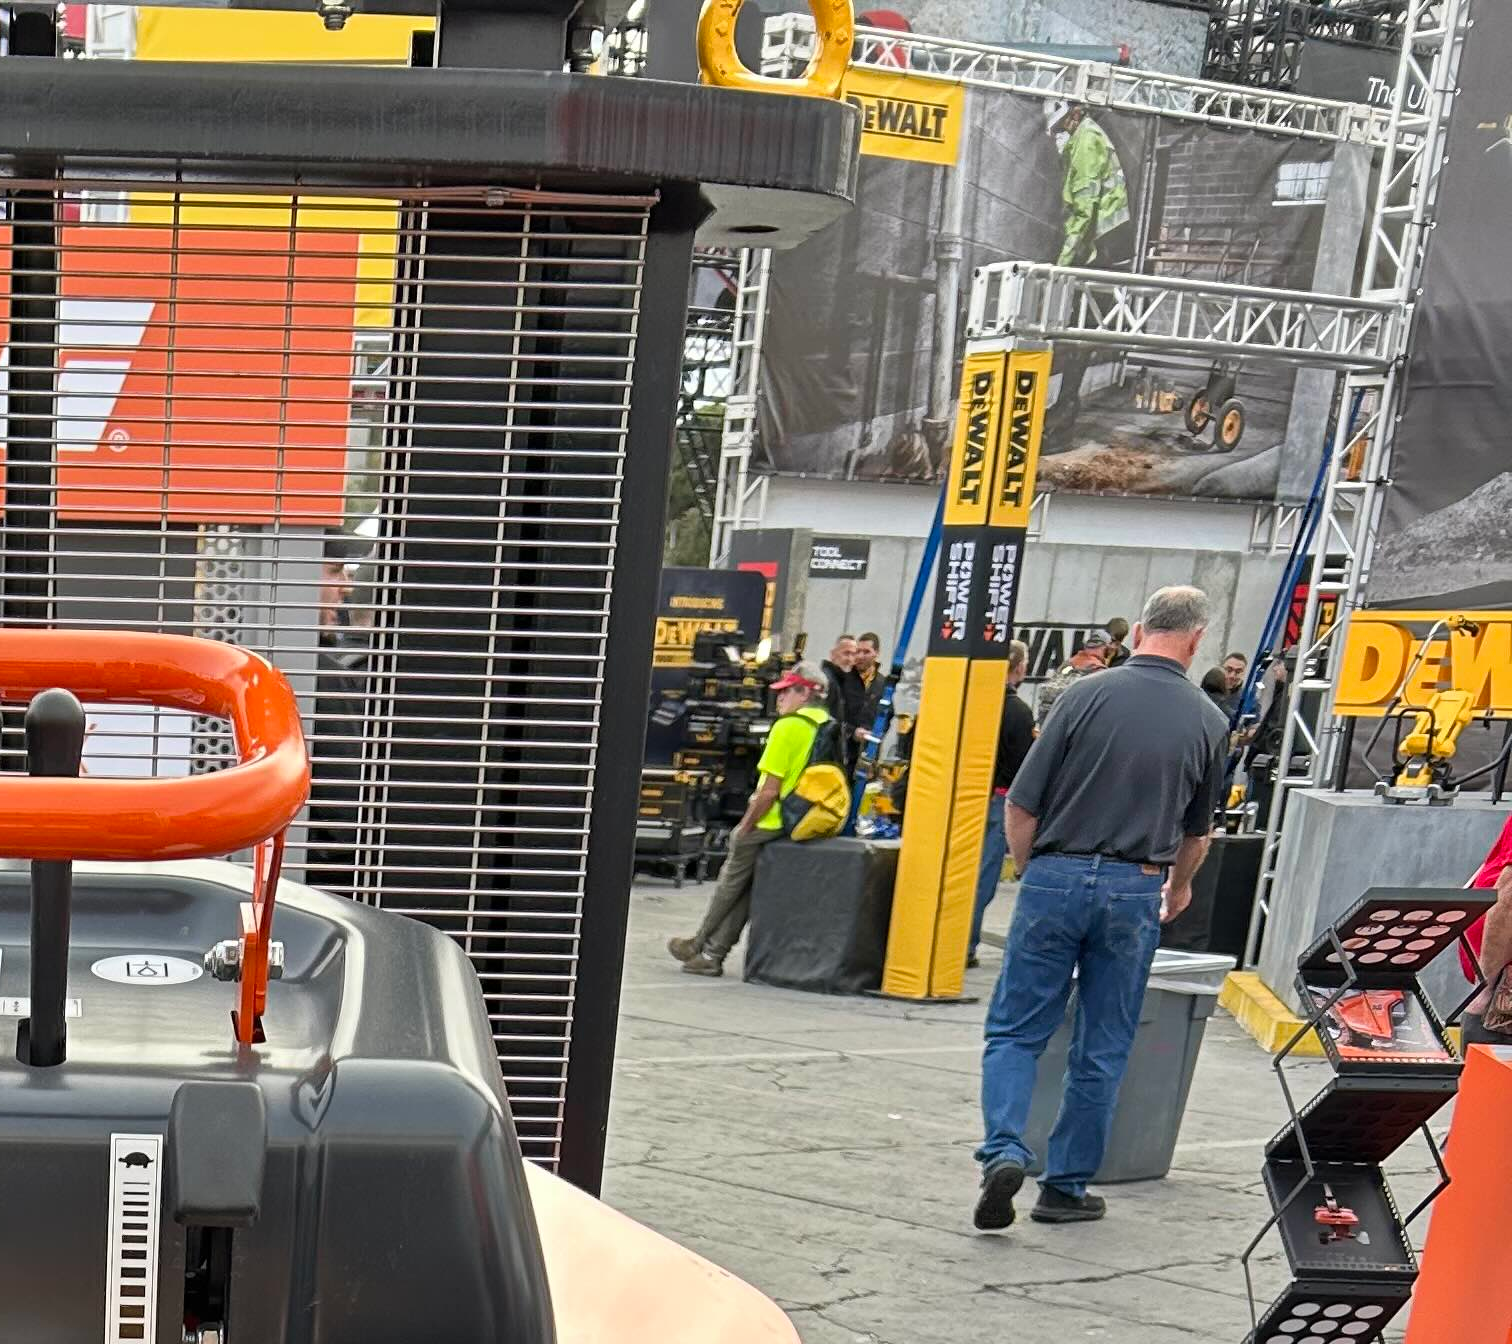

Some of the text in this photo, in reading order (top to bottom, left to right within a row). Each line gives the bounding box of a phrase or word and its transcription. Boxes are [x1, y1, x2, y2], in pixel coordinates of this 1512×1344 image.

[960, 371, 995, 505] DEWALT
[1003, 371, 1035, 507] DEWALT
[943, 542, 963, 624] SHIFT
[952, 541, 976, 642] POWER
[985, 544, 1005, 621] SHIFT
[994, 544, 1018, 644] POWER
